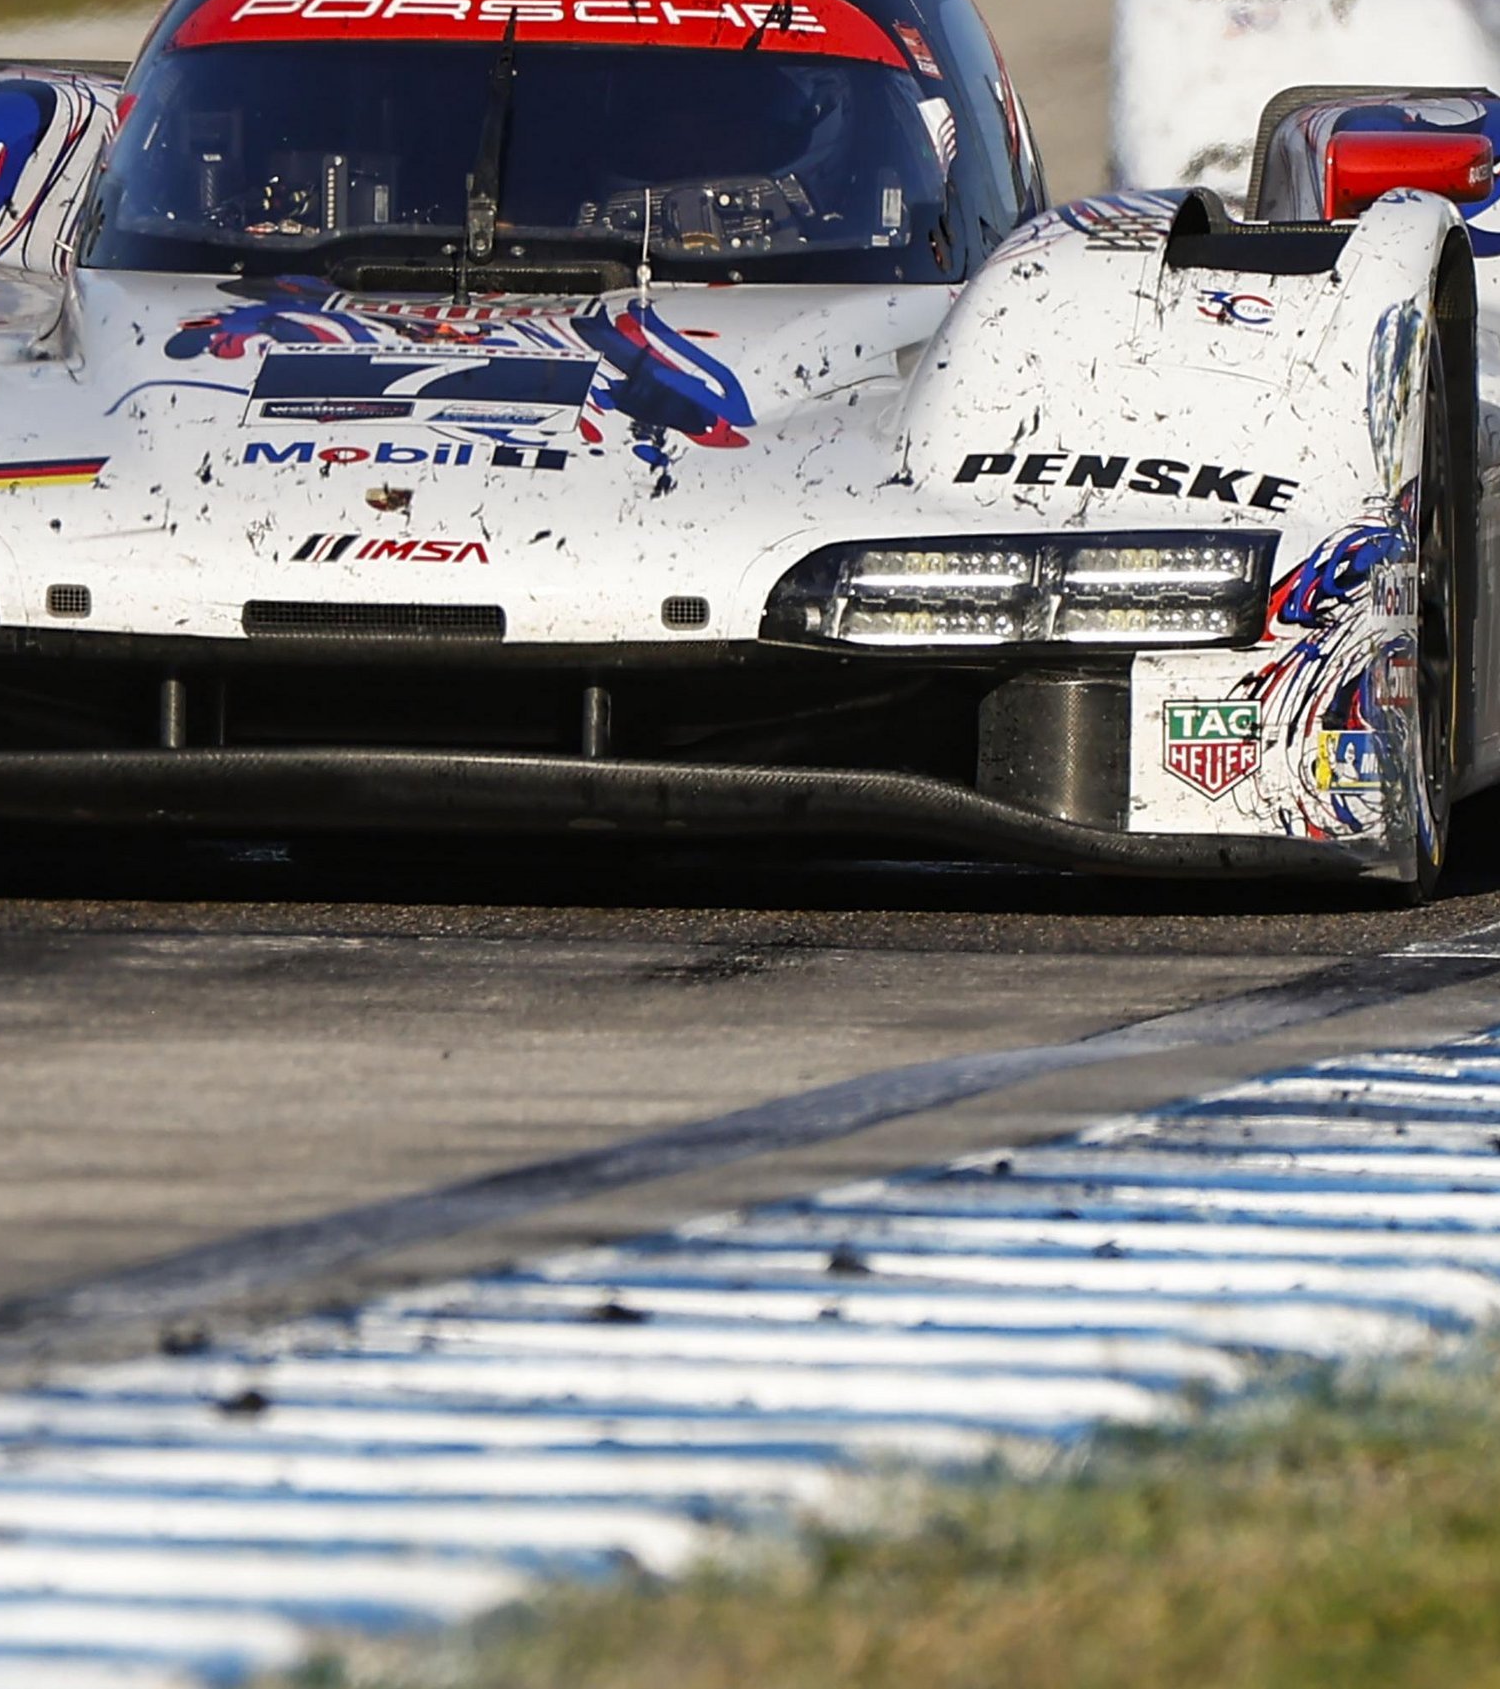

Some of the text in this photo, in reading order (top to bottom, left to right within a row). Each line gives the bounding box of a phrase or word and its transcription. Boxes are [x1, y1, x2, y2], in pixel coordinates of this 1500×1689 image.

[369, 355, 491, 396] 7
[242, 441, 475, 466] Mobil
[951, 453, 1301, 513] PENSKE
[354, 538, 490, 564] IMSA
[1172, 708, 1254, 737] TAG
[1170, 745, 1256, 791] HEUER
